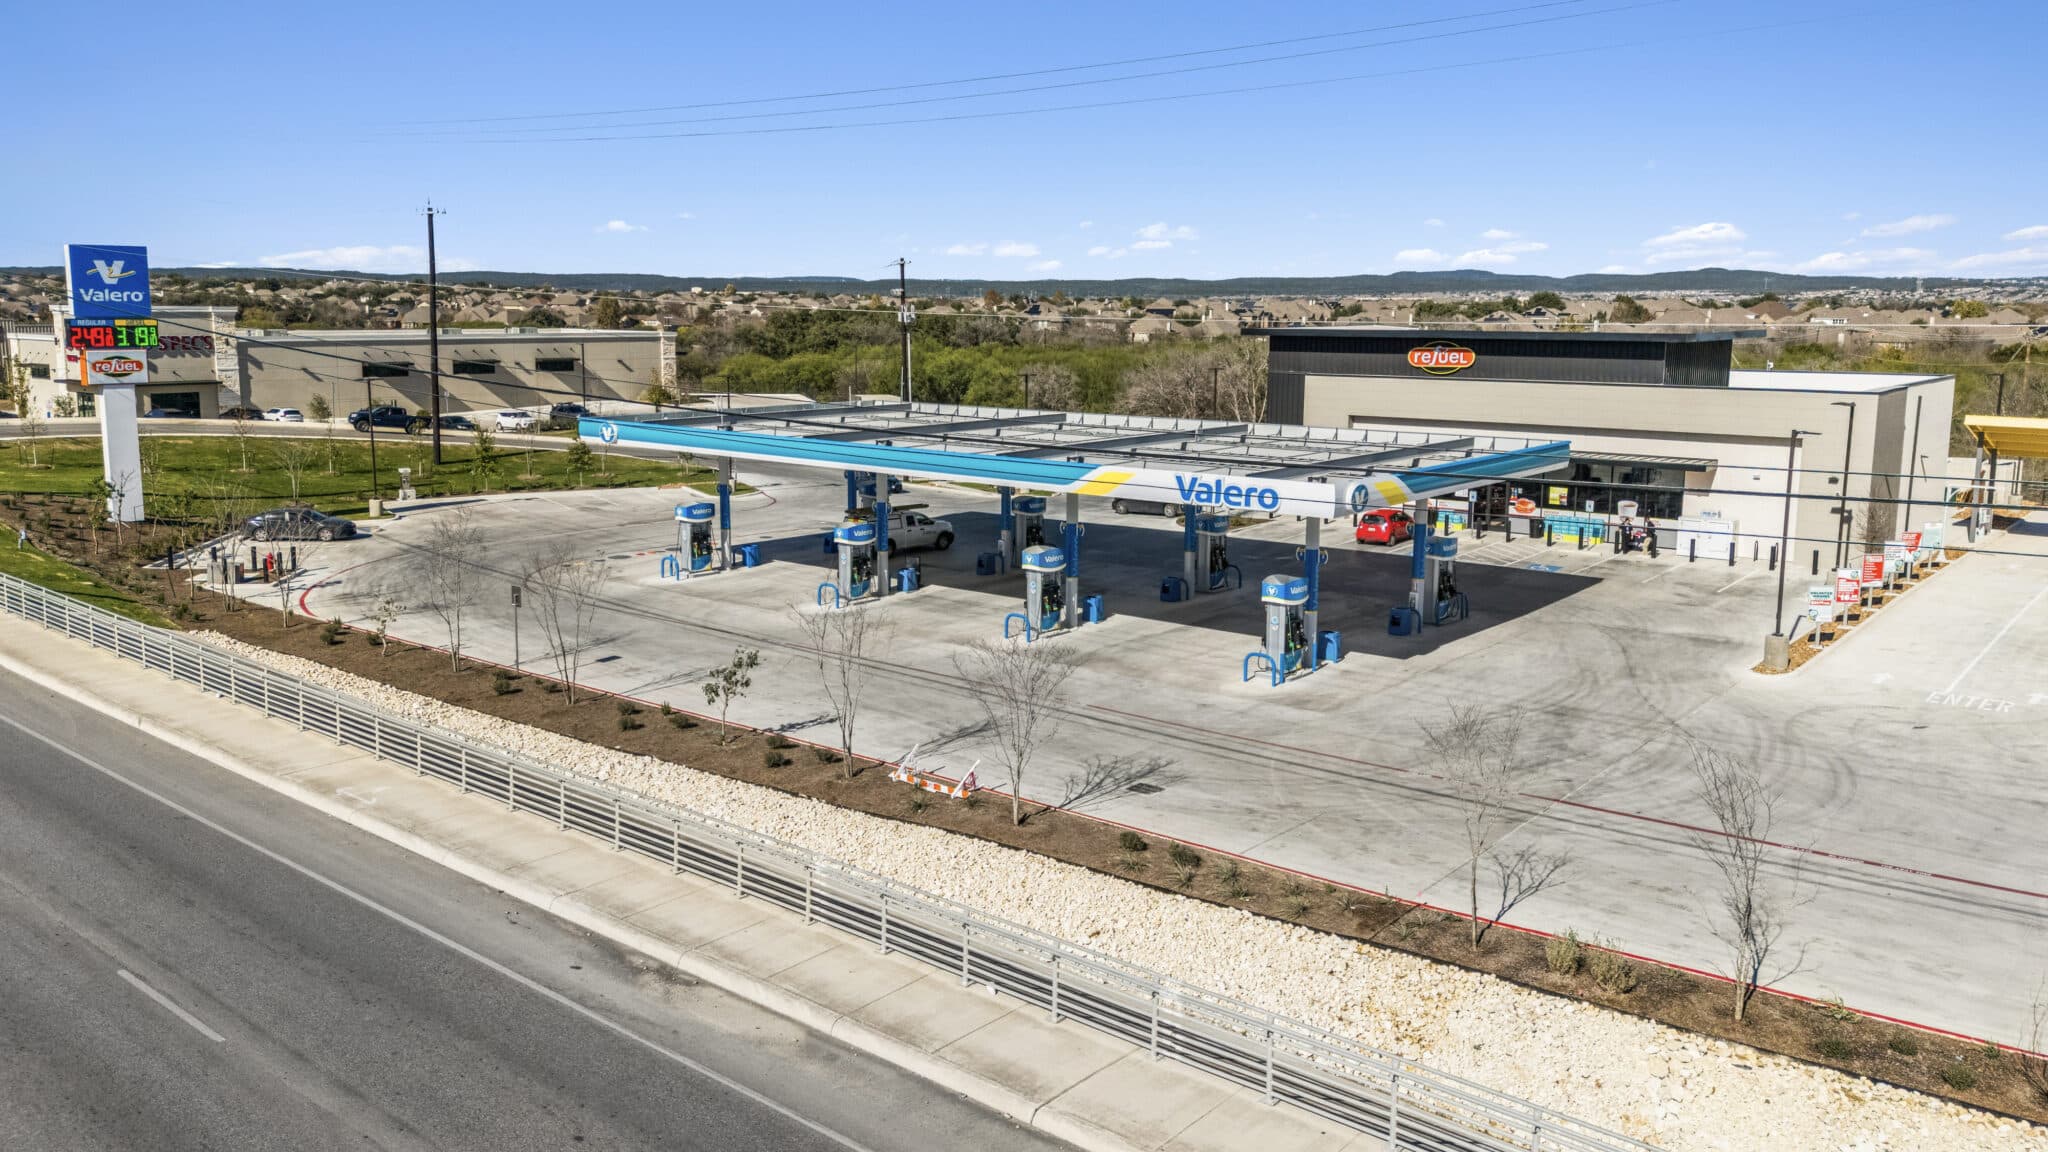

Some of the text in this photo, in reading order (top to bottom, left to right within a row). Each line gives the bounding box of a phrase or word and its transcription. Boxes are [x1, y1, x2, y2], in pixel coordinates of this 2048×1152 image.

[79, 288, 144, 302] Valero
[1175, 475, 1280, 510] Valero
[1925, 691, 2016, 712] ENTER
